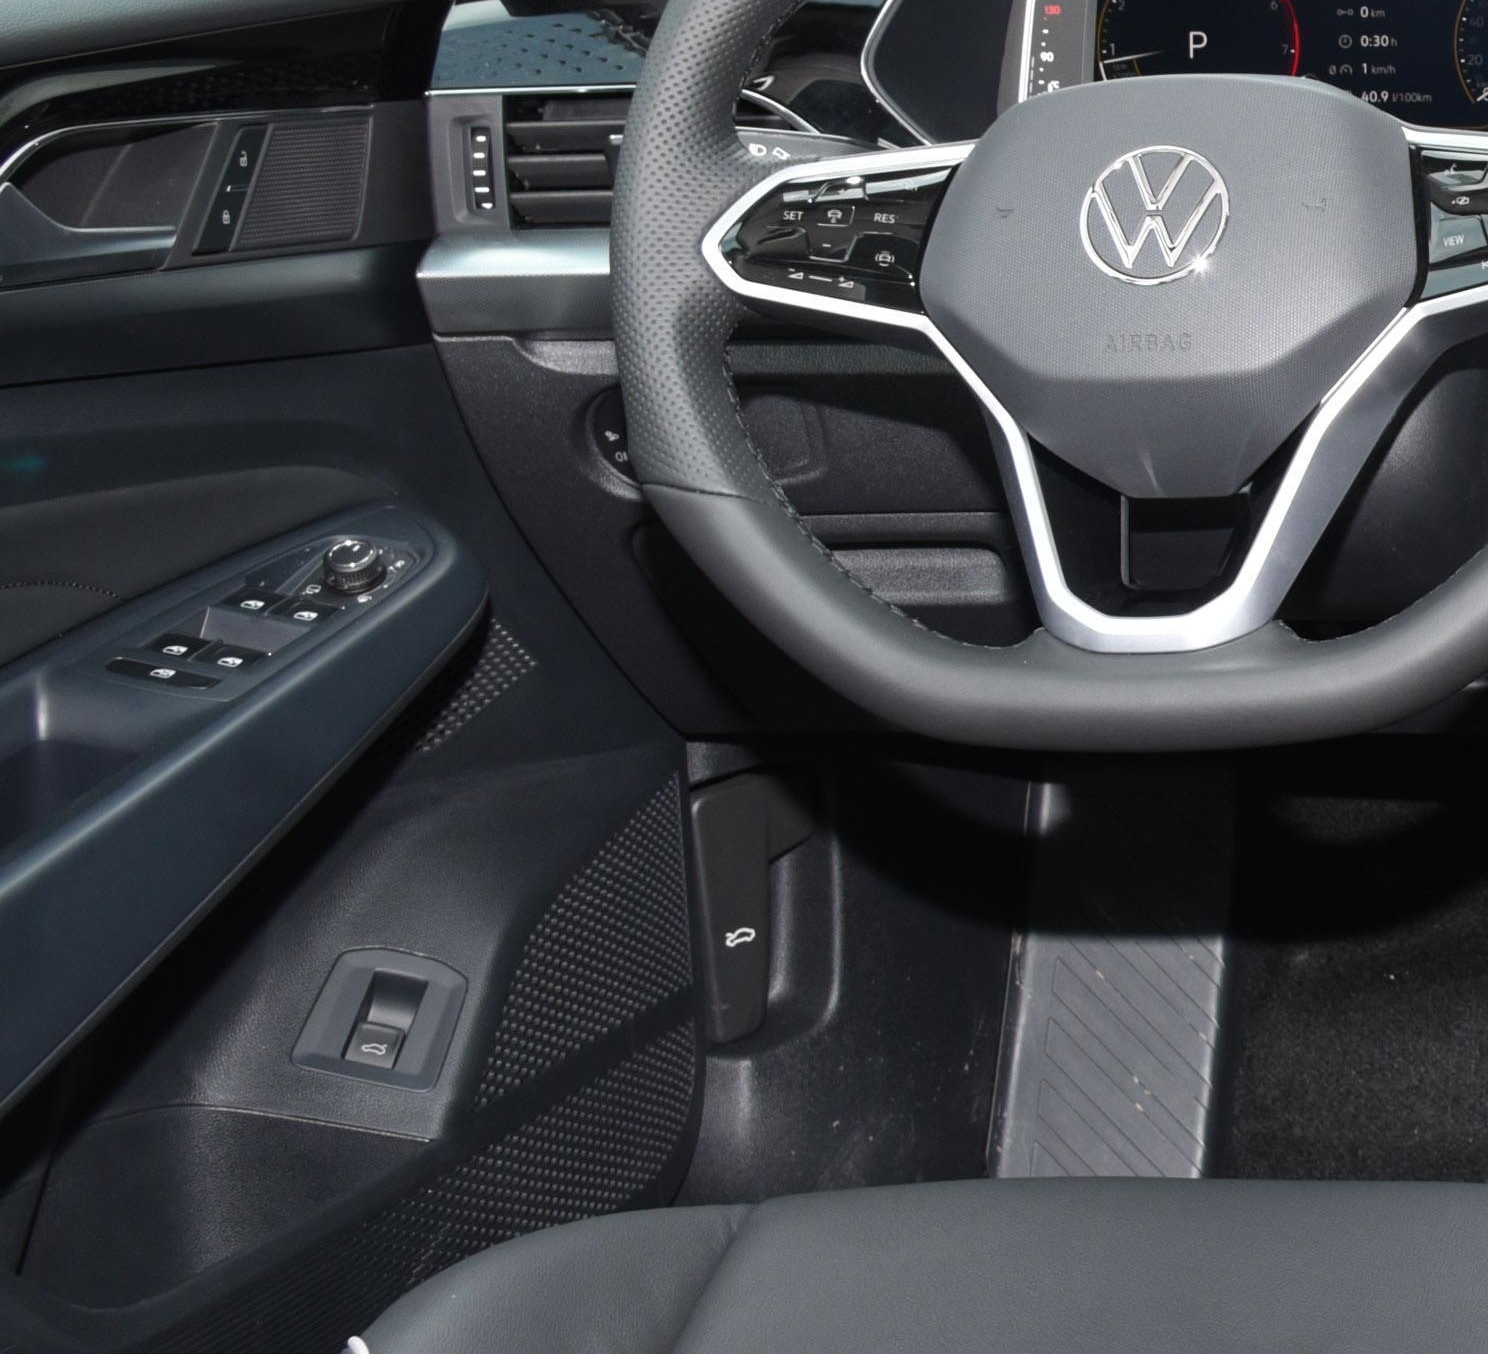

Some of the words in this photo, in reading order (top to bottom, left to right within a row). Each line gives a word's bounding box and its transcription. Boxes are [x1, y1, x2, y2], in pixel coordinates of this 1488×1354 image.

[1360, 6, 1369, 18] 0
[1371, 8, 1385, 18] km
[1189, 31, 1208, 59] P
[1360, 35, 1389, 47] 0:30
[1467, 54, 1483, 65] 20
[1371, 65, 1396, 75] km/h
[1361, 91, 1389, 103] 40.9
[783, 211, 803, 220] SET
[874, 213, 896, 223] RES
[1443, 235, 1464, 246] VIEW
[1104, 332, 1192, 353] AIRBAG
